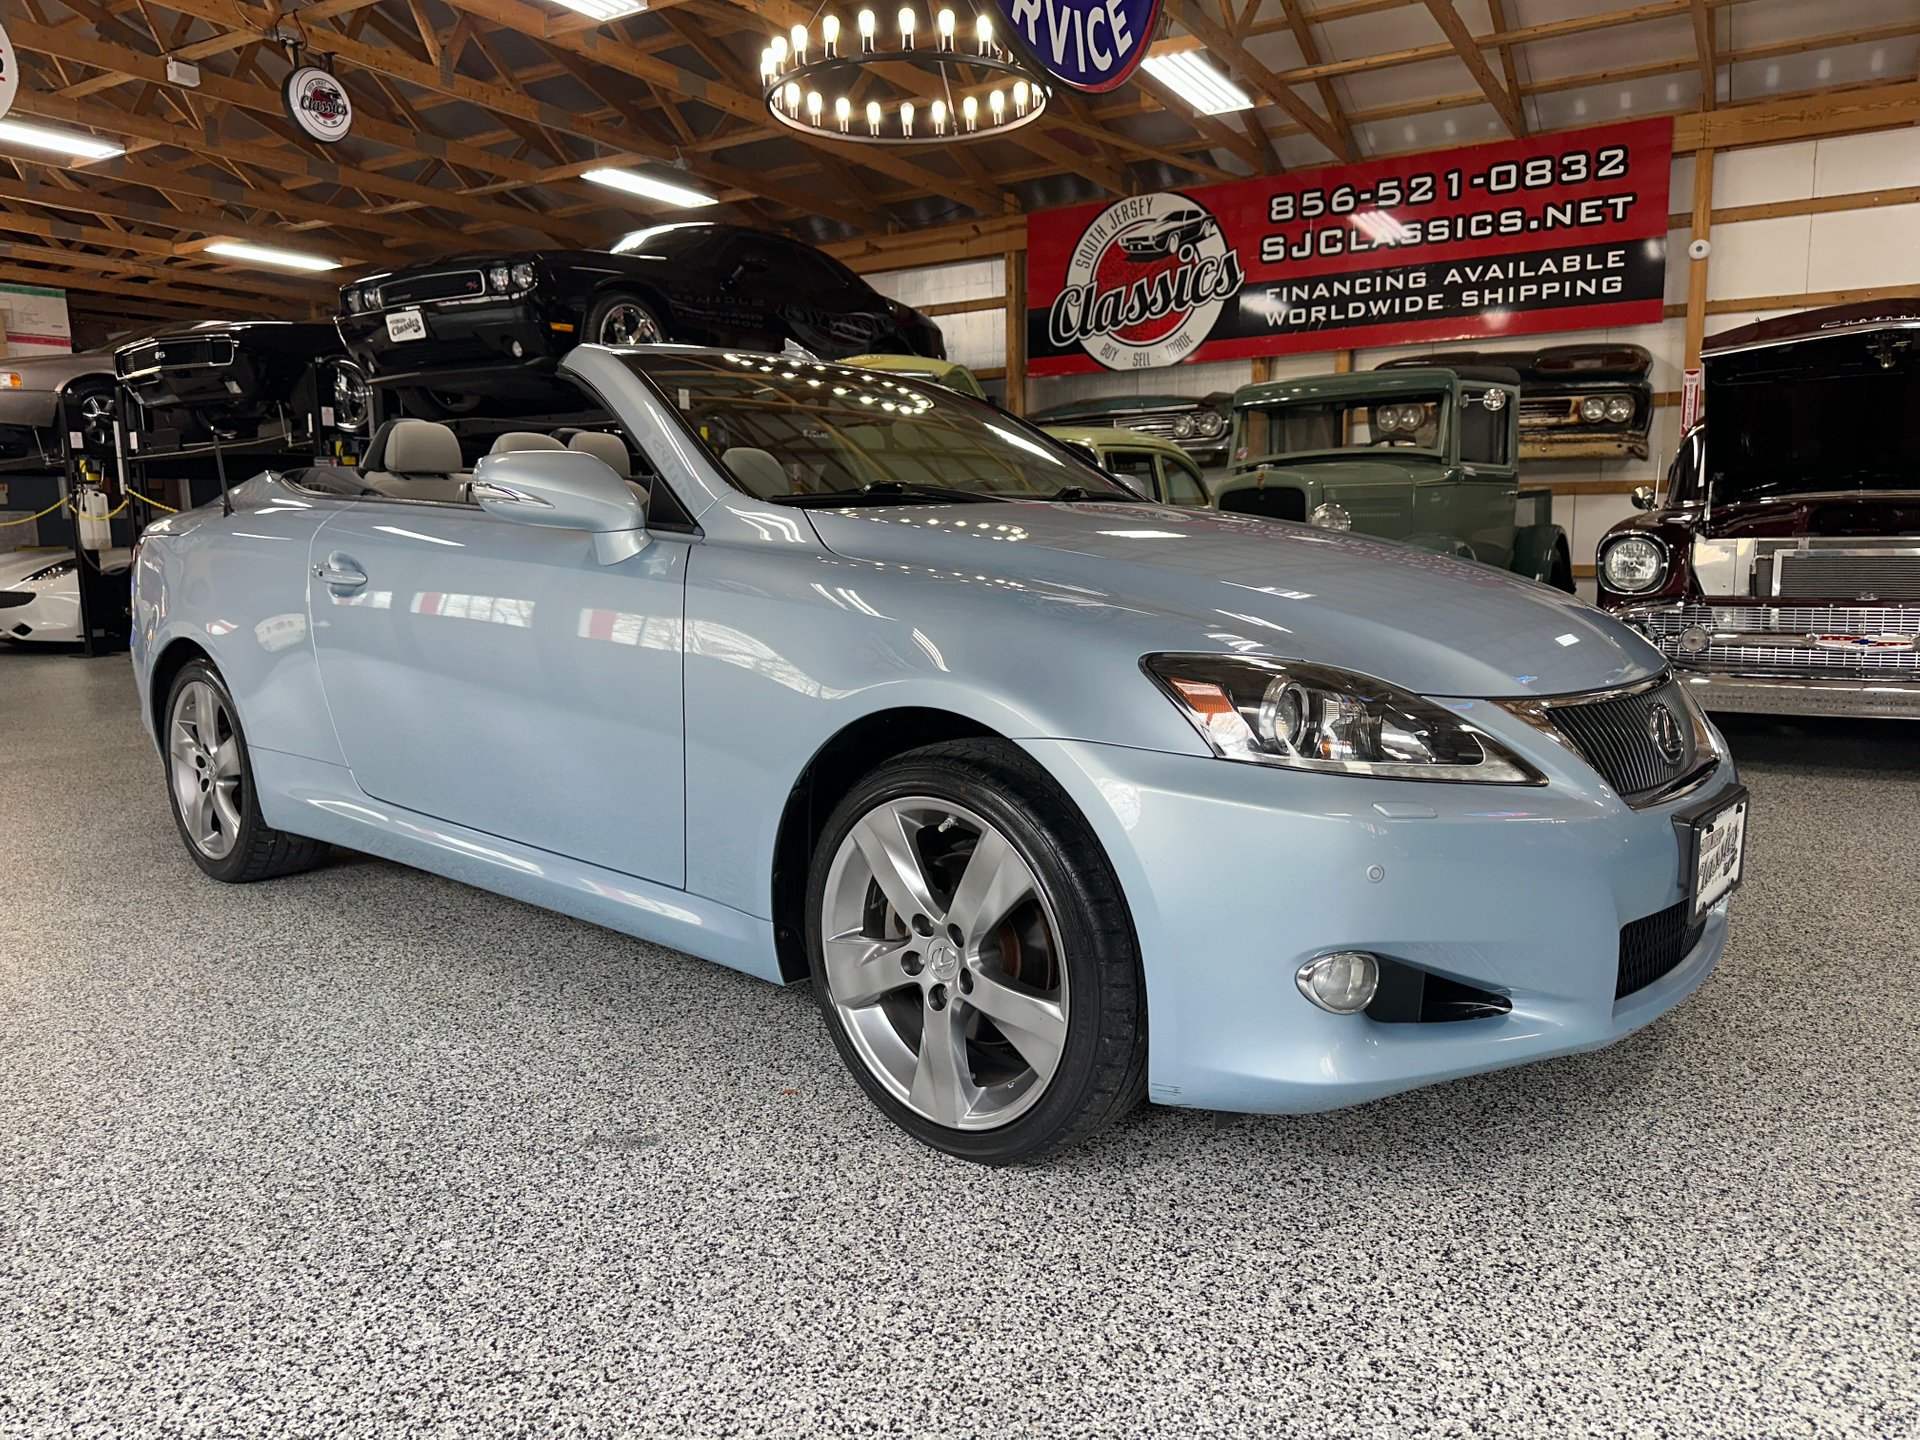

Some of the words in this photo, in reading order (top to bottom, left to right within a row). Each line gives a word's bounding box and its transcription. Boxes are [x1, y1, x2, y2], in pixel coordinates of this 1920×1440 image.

[301, 95, 348, 116] Classics
[1269, 147, 1627, 223] 856-521-0832
[1075, 224, 1107, 270] SOUTH
[1110, 196, 1154, 231] JERSEY
[1260, 194, 1635, 263] SJCLASSICS.NET
[1048, 243, 1246, 348] Classics
[1265, 271, 1427, 304] FINANCING
[1442, 249, 1626, 286] AVAILABLE
[1265, 294, 1445, 327] WORLDWIDE
[1460, 275, 1623, 308] SHIPPING
[1100, 342, 1119, 362] BUY
[1132, 351, 1151, 368] SELL
[1165, 331, 1194, 358] TRADE
